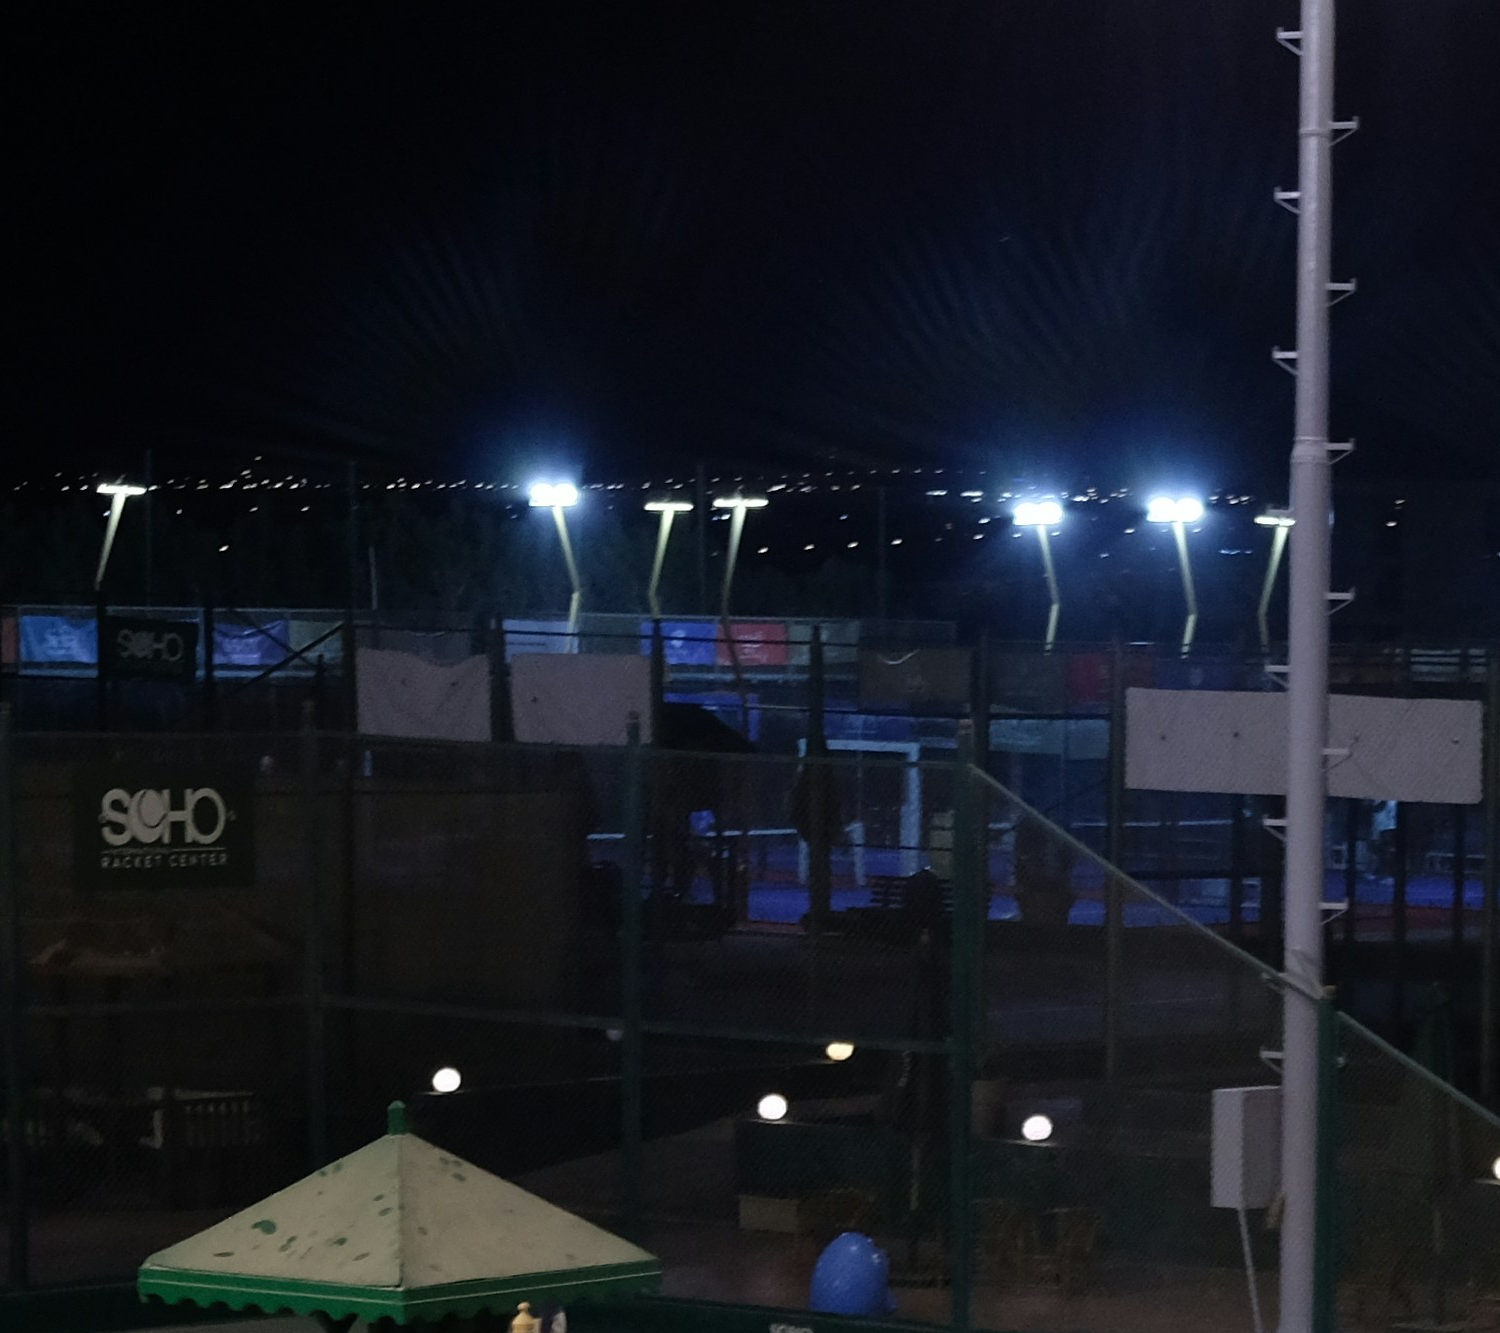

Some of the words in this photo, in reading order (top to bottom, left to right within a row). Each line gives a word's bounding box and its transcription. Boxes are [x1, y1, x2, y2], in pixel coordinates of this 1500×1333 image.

[101, 787, 228, 846] SOHO
[101, 854, 163, 869] RACKET
[168, 853, 229, 868] CENTER
